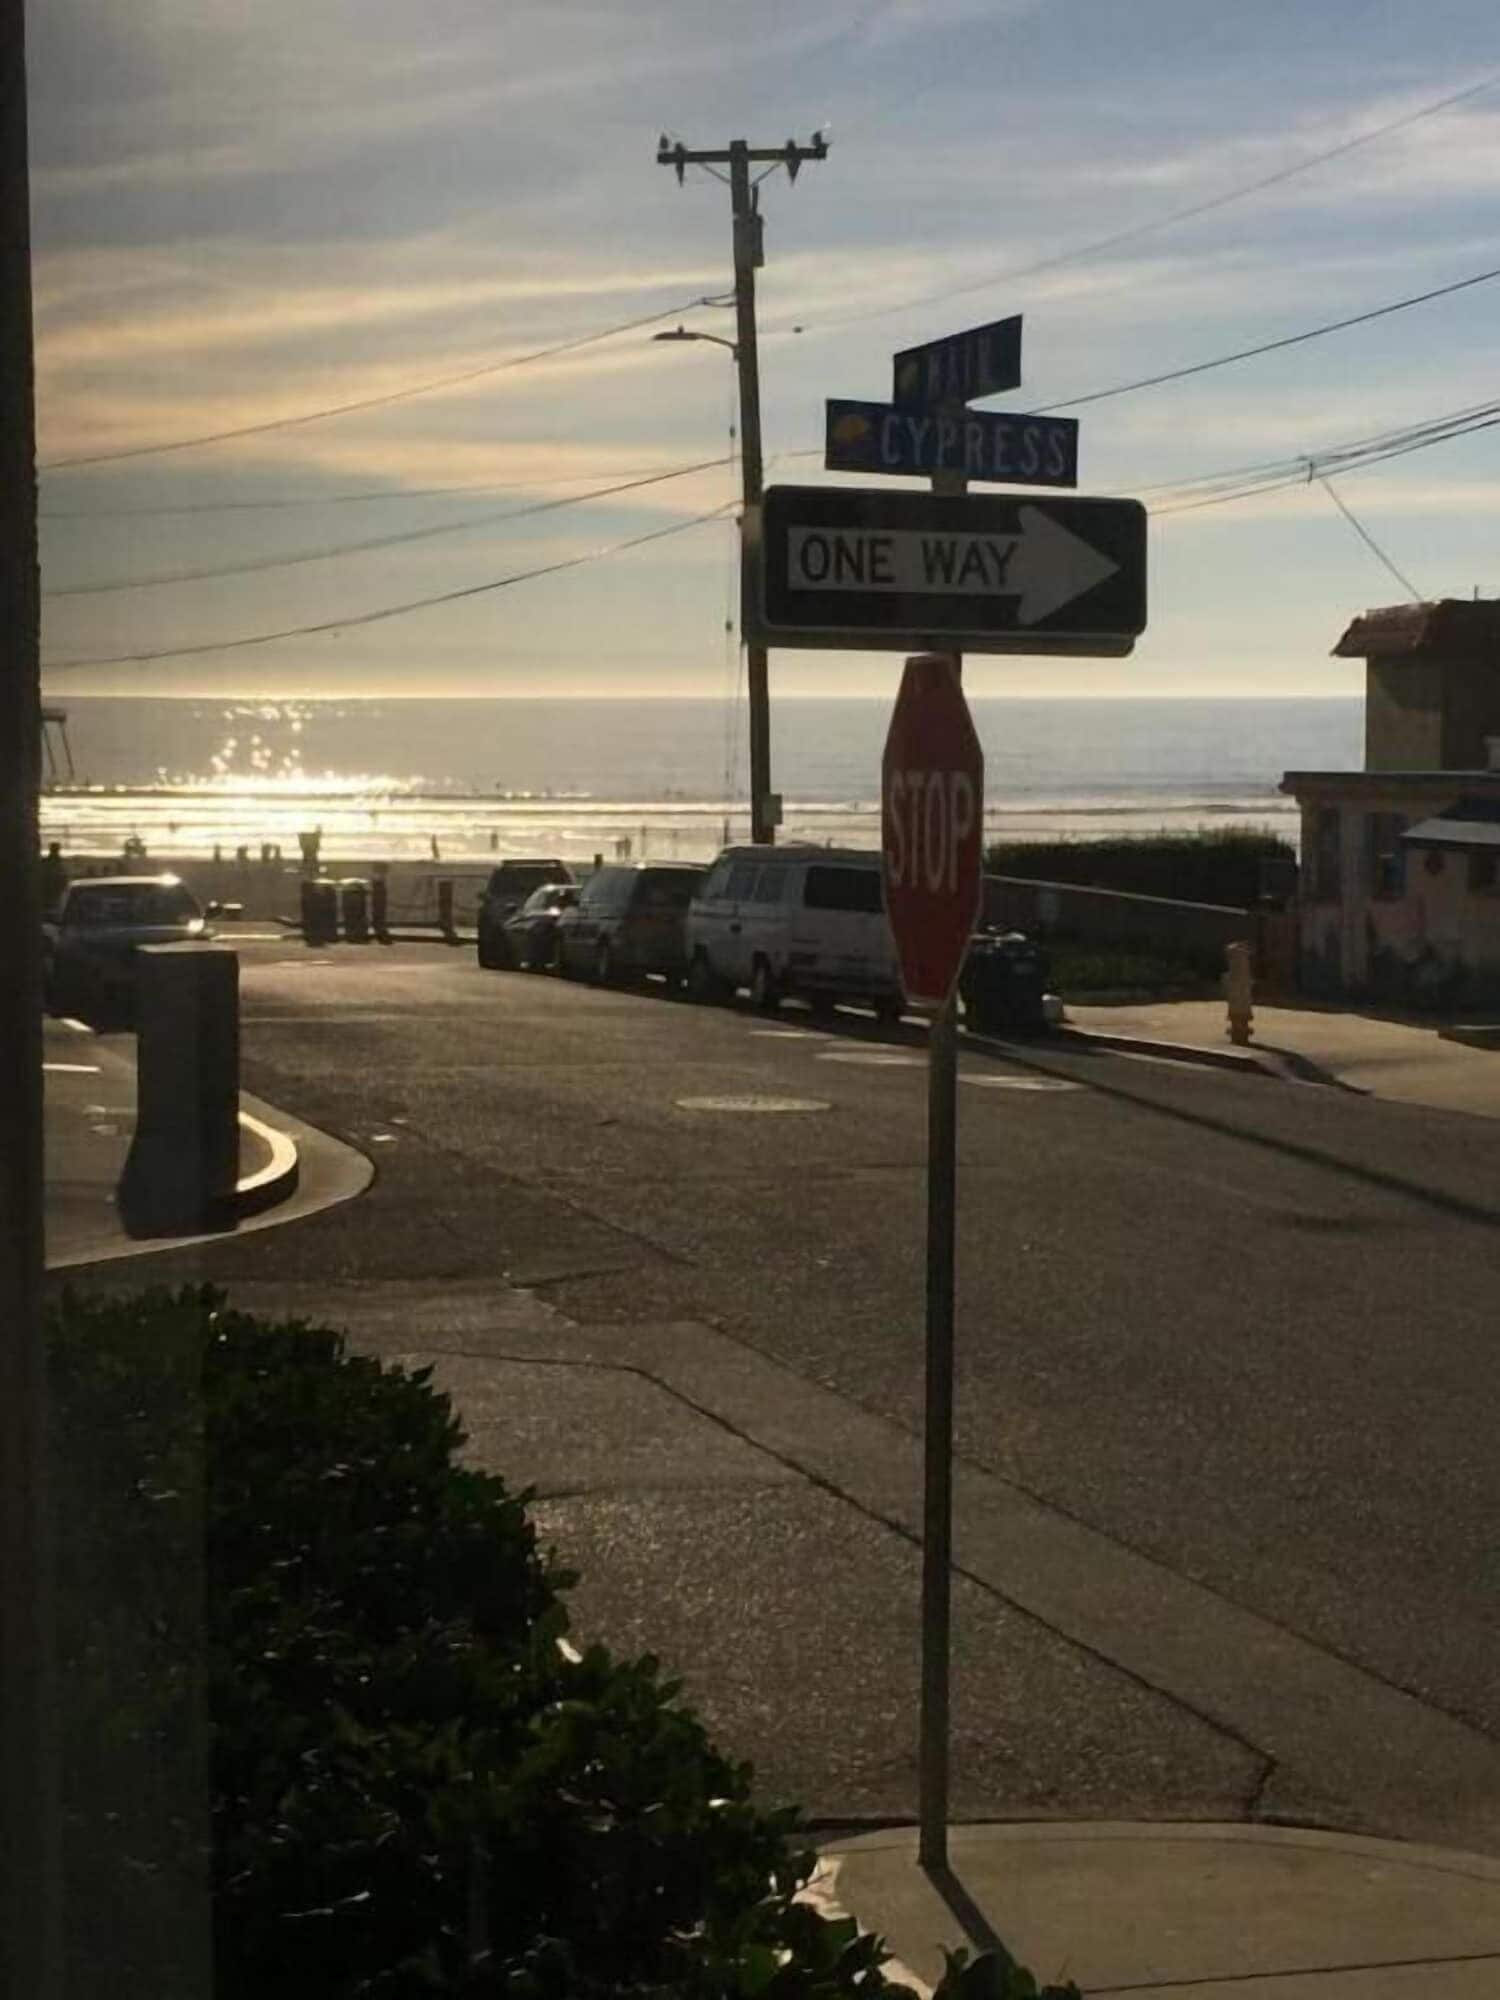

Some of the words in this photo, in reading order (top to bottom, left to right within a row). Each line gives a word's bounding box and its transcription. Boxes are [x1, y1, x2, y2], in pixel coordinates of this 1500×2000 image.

[879, 413, 1067, 477] CYPRESS
[800, 534, 895, 584] ONE
[921, 540, 1018, 587] WAY
[887, 769, 975, 895] STOP
